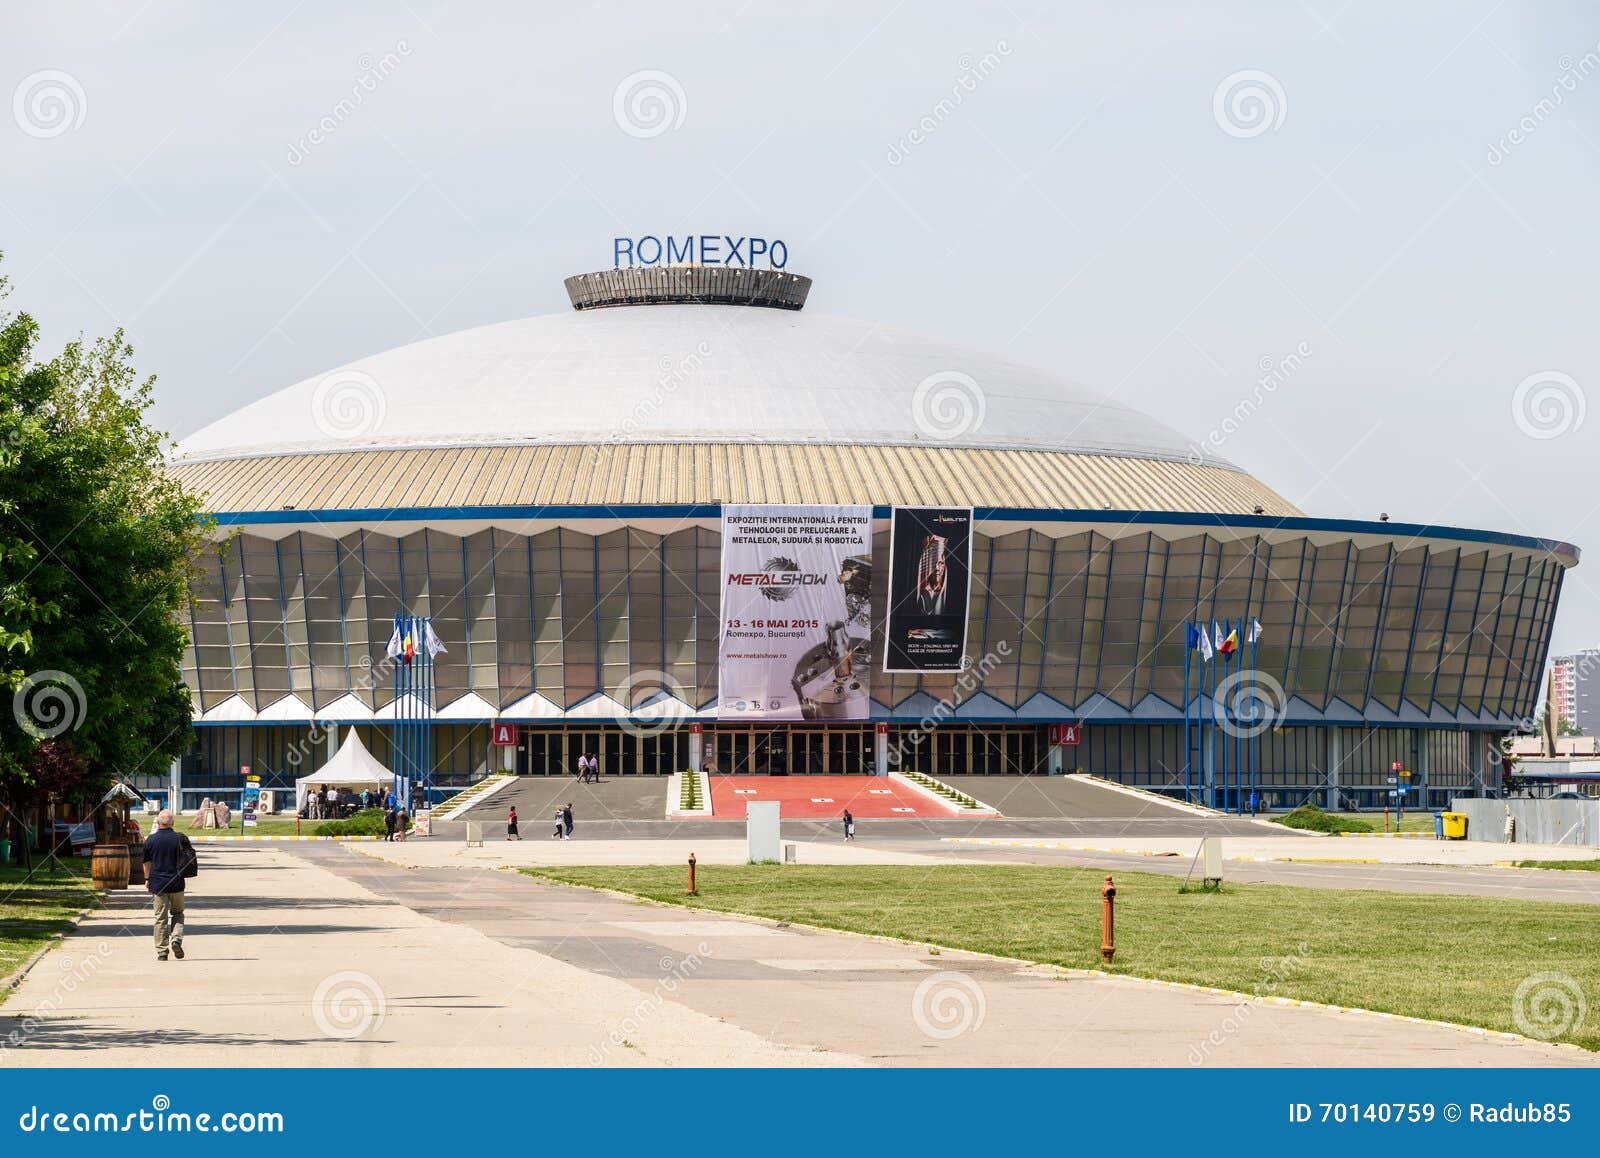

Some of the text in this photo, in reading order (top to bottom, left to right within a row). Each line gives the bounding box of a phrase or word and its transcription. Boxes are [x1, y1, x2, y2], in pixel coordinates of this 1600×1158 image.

[614, 235, 788, 269] ROMEXPO
[837, 516, 868, 525] PENTRU
[738, 526, 857, 534] TEHNOLOGII DE PRELUCRARE A
[732, 536, 780, 546] METALELOR,
[727, 573, 829, 586] METALSHOW
[727, 619, 741, 628] 13
[750, 619, 764, 628] 16
[767, 619, 788, 628] MAI
[791, 619, 819, 628] 2015
[726, 631, 766, 639] Romexpo,
[498, 726, 510, 741] A
[1066, 726, 1076, 741] A
